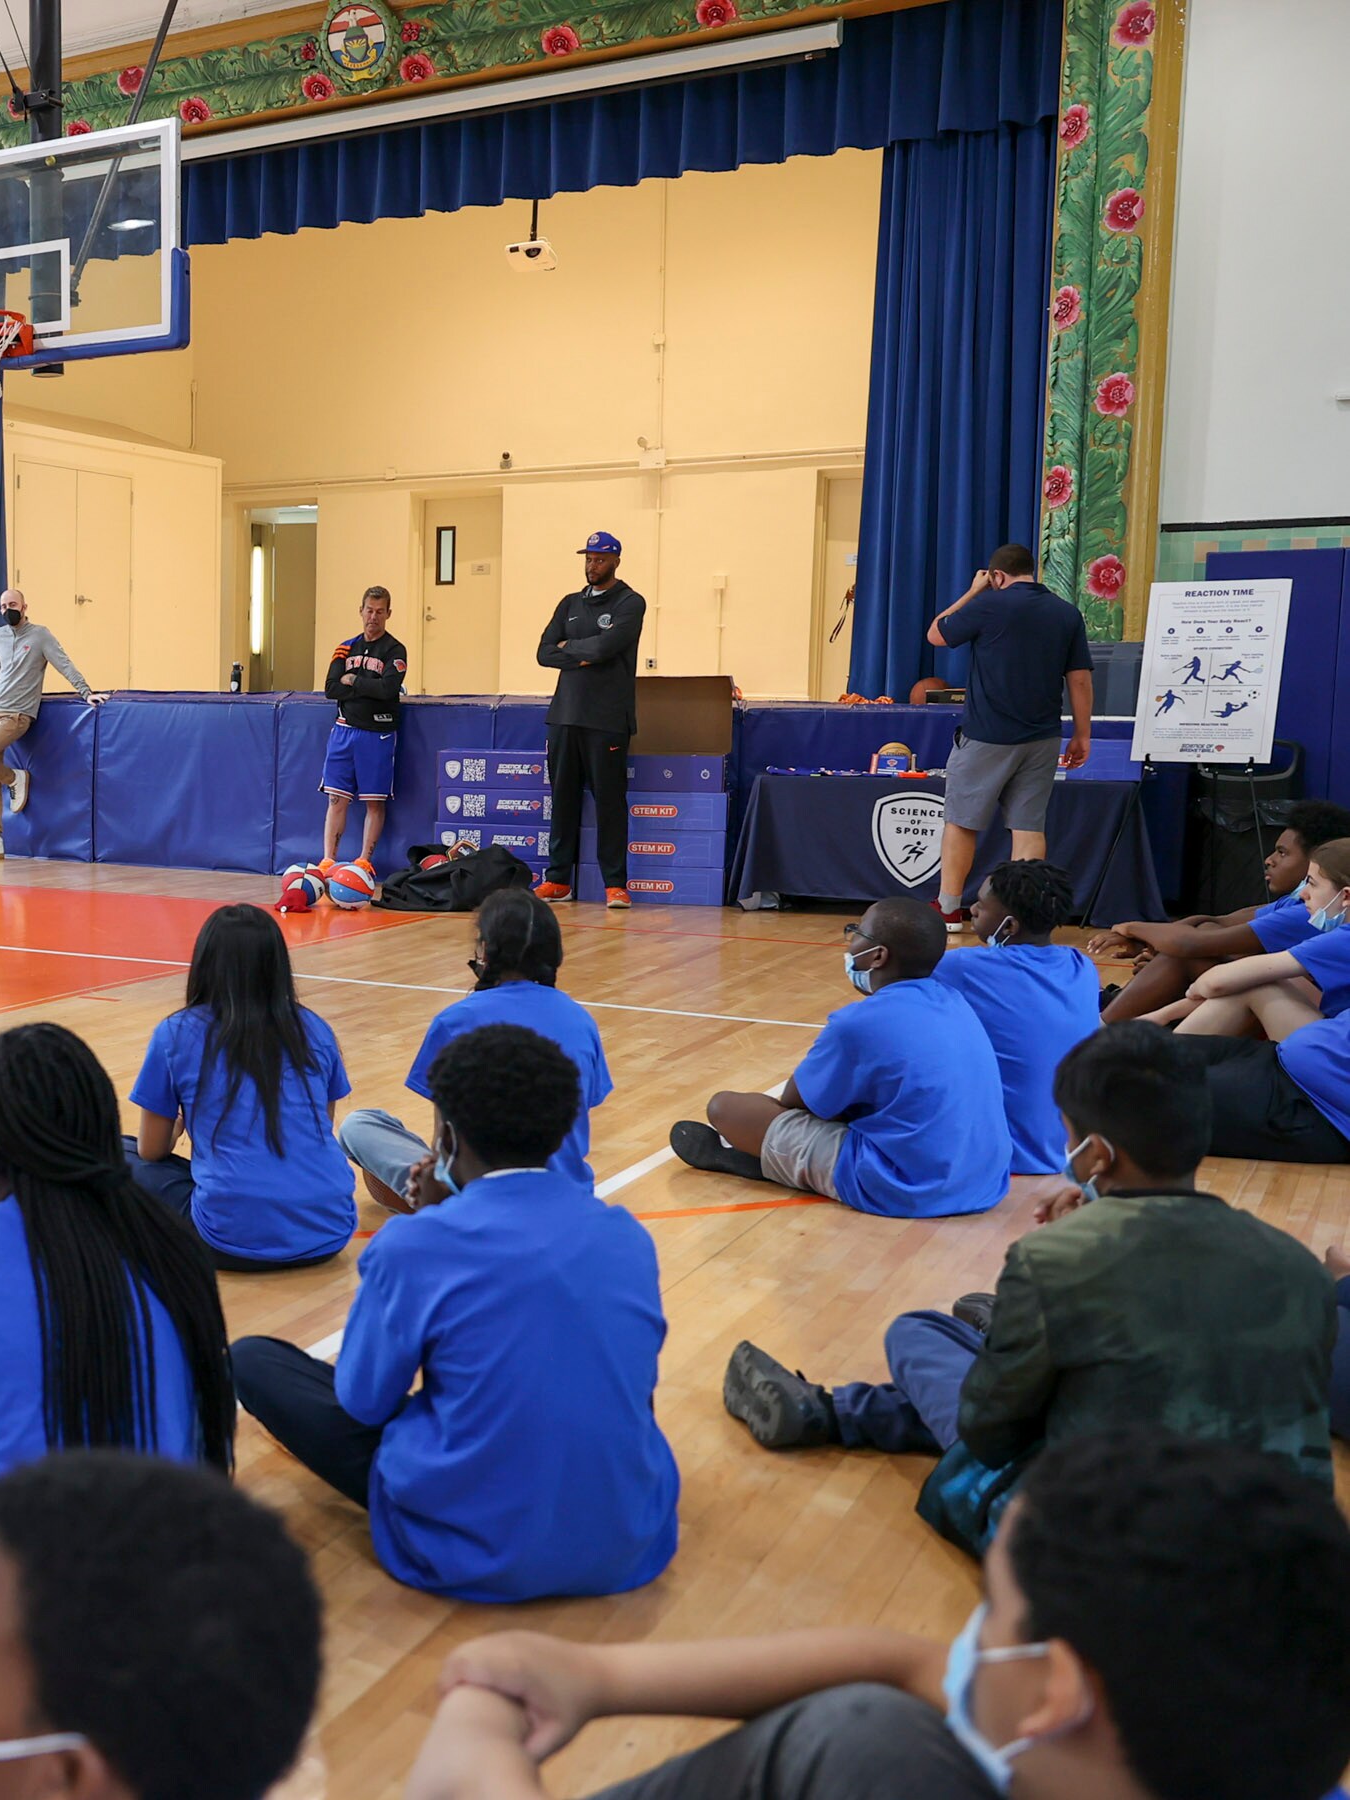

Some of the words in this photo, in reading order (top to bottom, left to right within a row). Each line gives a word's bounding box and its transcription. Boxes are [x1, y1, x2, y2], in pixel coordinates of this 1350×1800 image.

[1185, 589, 1230, 598] REACTION
[1232, 588, 1255, 596] TIME
[633, 807, 658, 815] STEM
[659, 807, 674, 815] KIT
[890, 806, 944, 818] SCIENCE
[895, 826, 936, 837] SPORT
[631, 844, 656, 852] STEM
[657, 844, 672, 852] KIT
[629, 881, 654, 890] STEM
[655, 882, 670, 890] KIT
